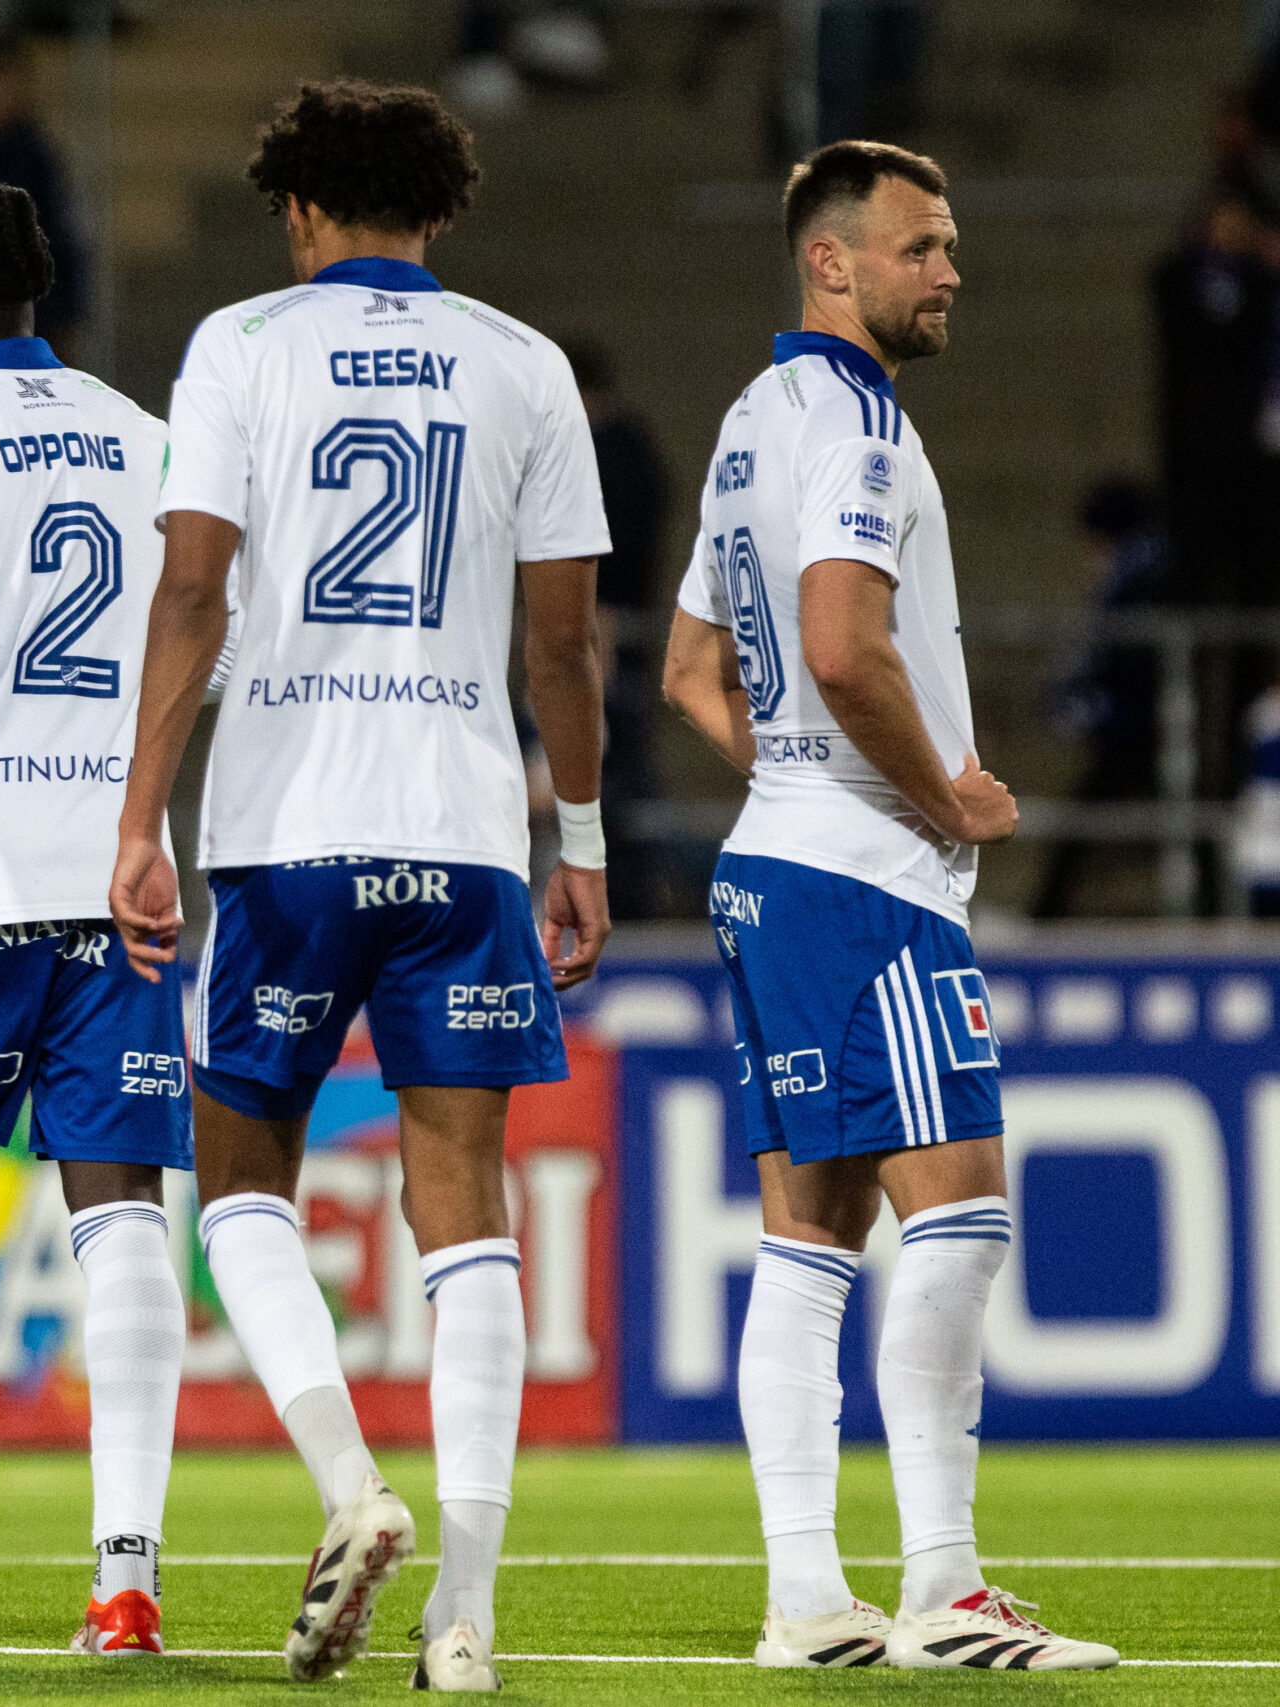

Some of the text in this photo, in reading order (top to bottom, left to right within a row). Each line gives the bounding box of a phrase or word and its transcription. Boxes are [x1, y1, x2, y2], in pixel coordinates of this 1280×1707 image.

[330, 348, 458, 391] CEESAY
[304, 417, 468, 628] 21
[12, 501, 123, 699] 2
[248, 674, 480, 711] PLATINUMCARS
[352, 862, 452, 910] RÖR
[447, 984, 502, 1006] pre
[256, 1007, 307, 1035] zero
[447, 1009, 519, 1030] zero
